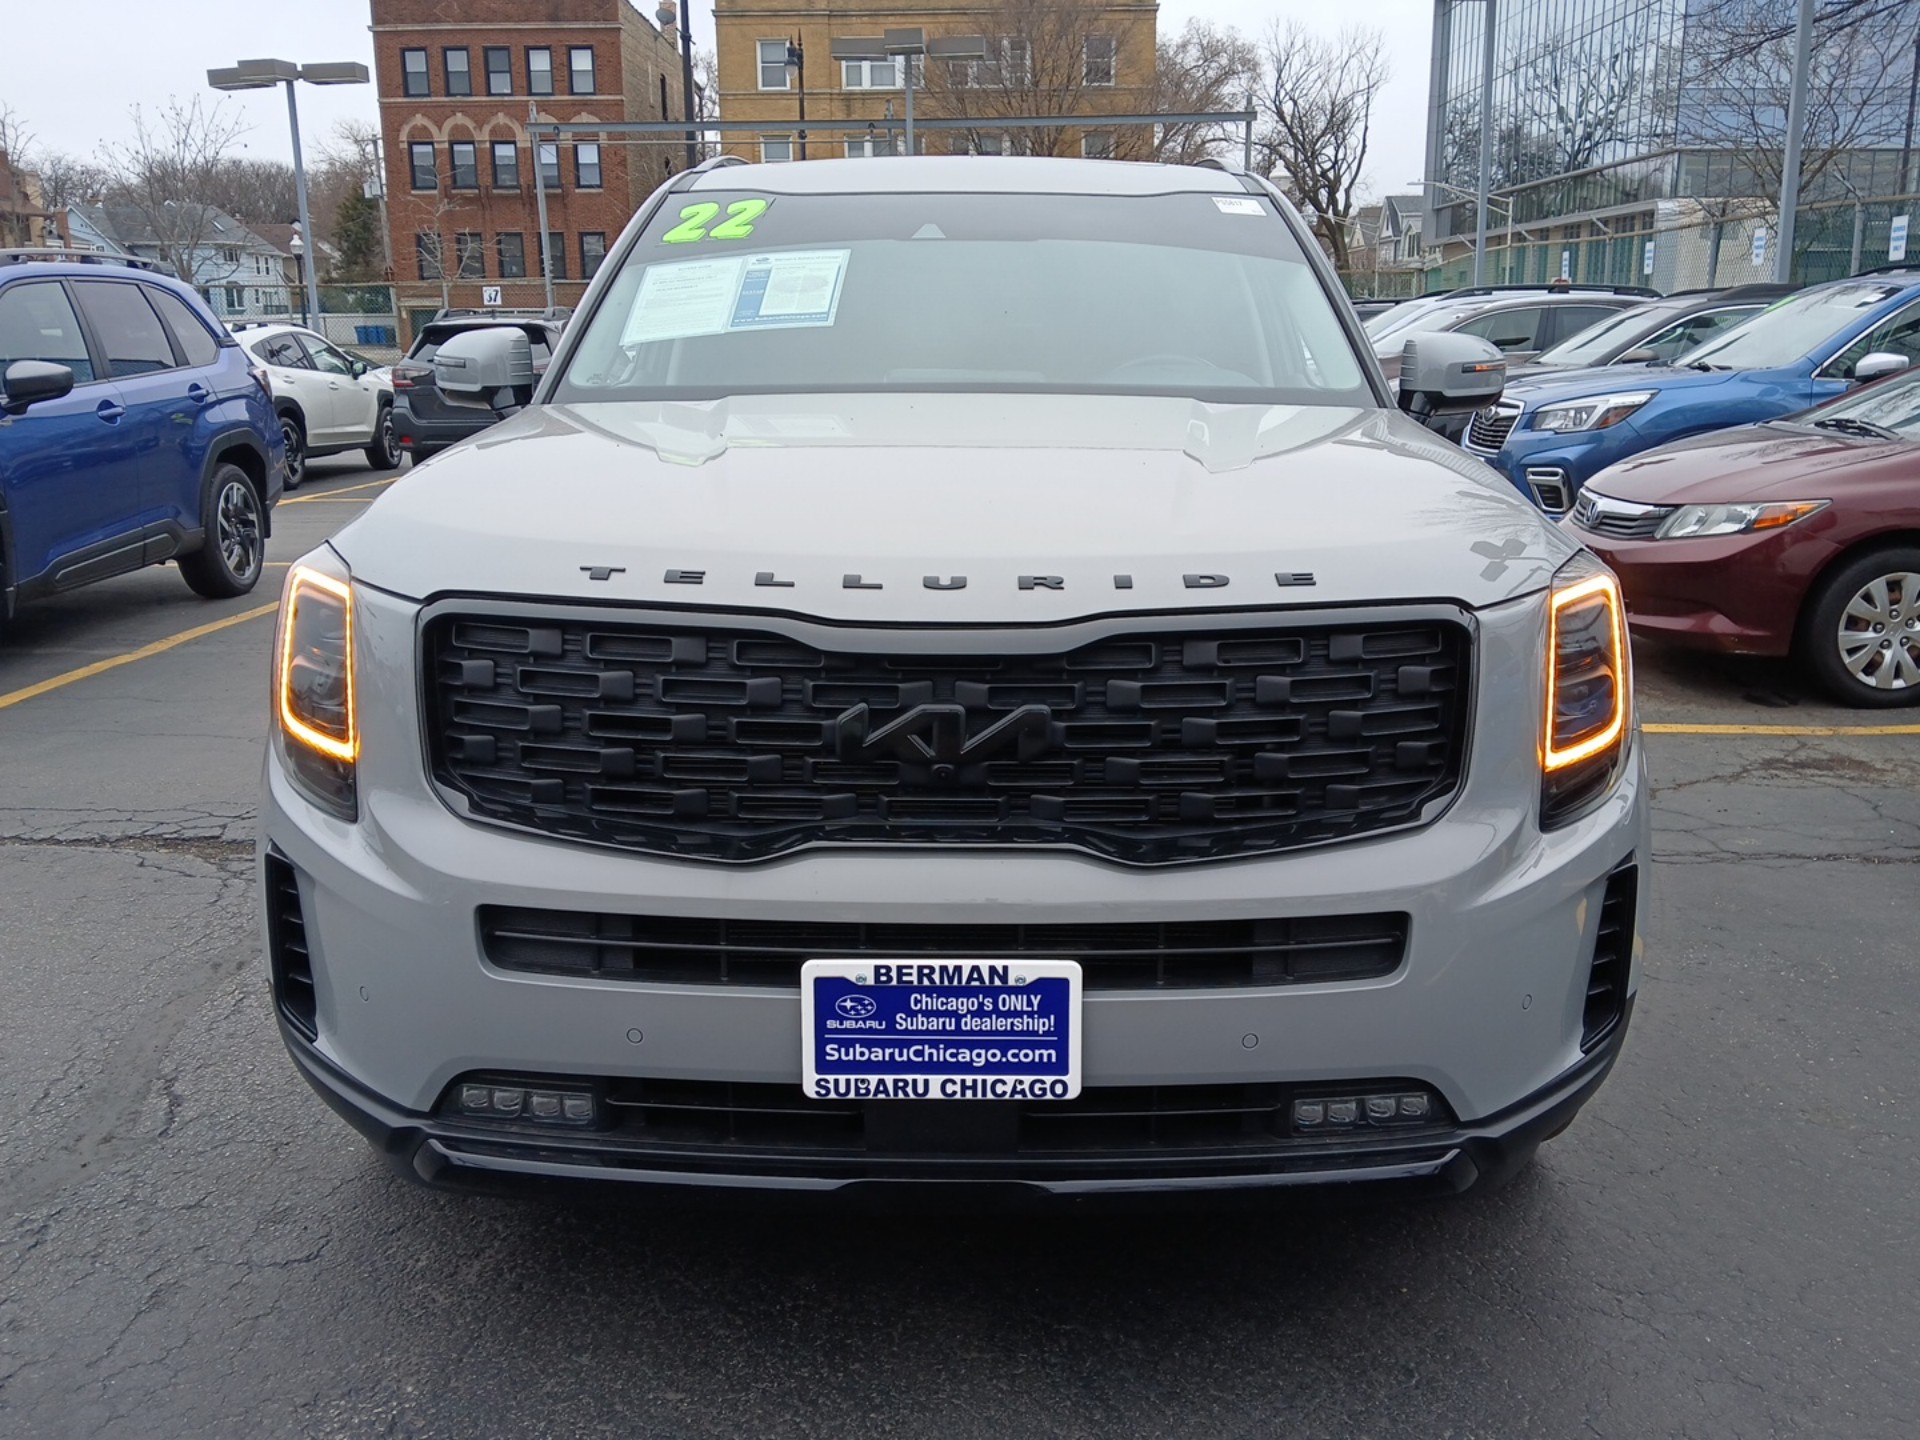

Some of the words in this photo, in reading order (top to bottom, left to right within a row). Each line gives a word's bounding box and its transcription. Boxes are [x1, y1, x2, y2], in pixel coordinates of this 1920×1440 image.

[661, 199, 768, 244] 22
[579, 565, 1317, 591] TELLURIDE
[873, 964, 1009, 986] BERMAN
[909, 992, 993, 1014] Chicago's
[998, 993, 1042, 1012] ONLY
[826, 1019, 886, 1029] SUBARU
[895, 1013, 956, 1031] Subaru
[960, 1013, 1055, 1034] dealership!
[824, 1043, 1057, 1067] SubaruChicago.com
[814, 1077, 930, 1098] SUBARU
[939, 1078, 1069, 1099] CHICAGO
